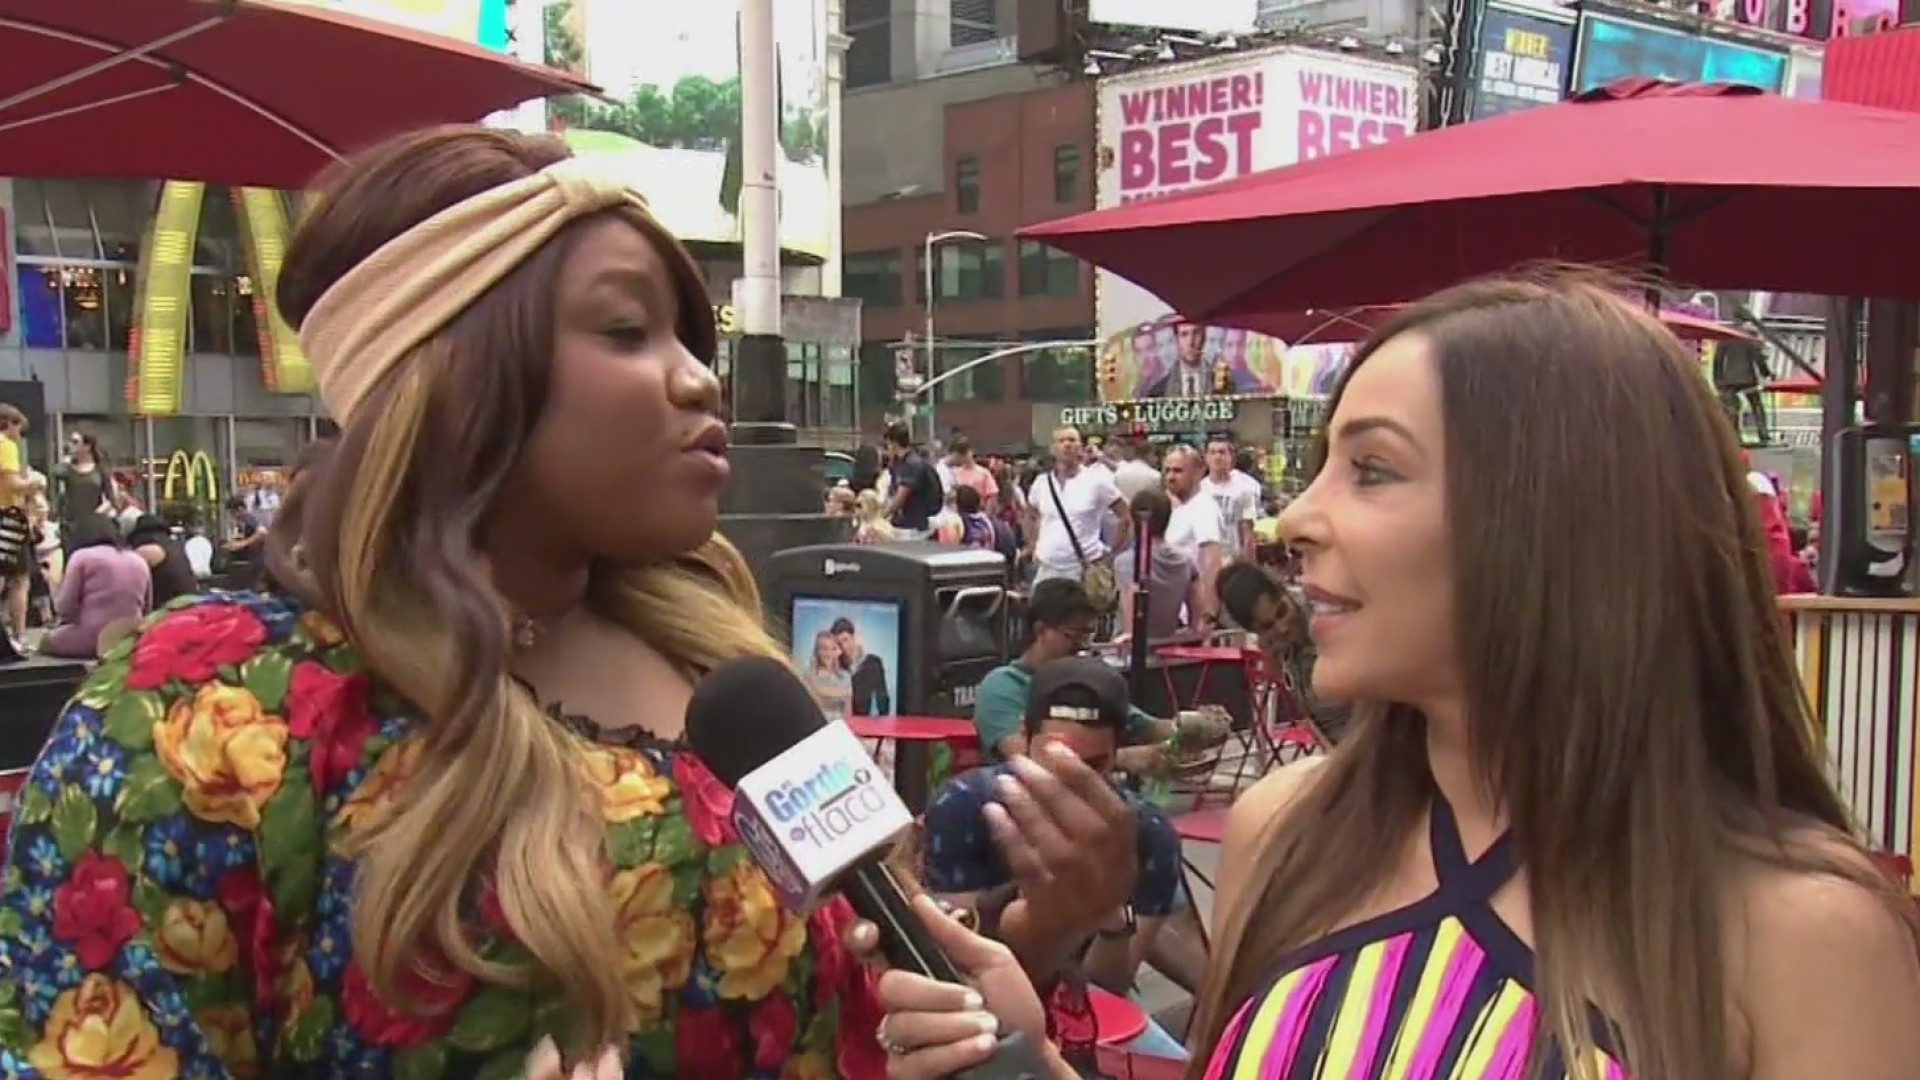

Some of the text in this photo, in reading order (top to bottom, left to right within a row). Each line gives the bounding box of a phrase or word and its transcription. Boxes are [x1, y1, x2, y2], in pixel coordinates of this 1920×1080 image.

[1119, 72, 1264, 125] WINNER!
[1298, 70, 1408, 119] WINNER!
[1120, 112, 1261, 190] BEST
[1061, 401, 1234, 424] GIFTS LUGGAGE
